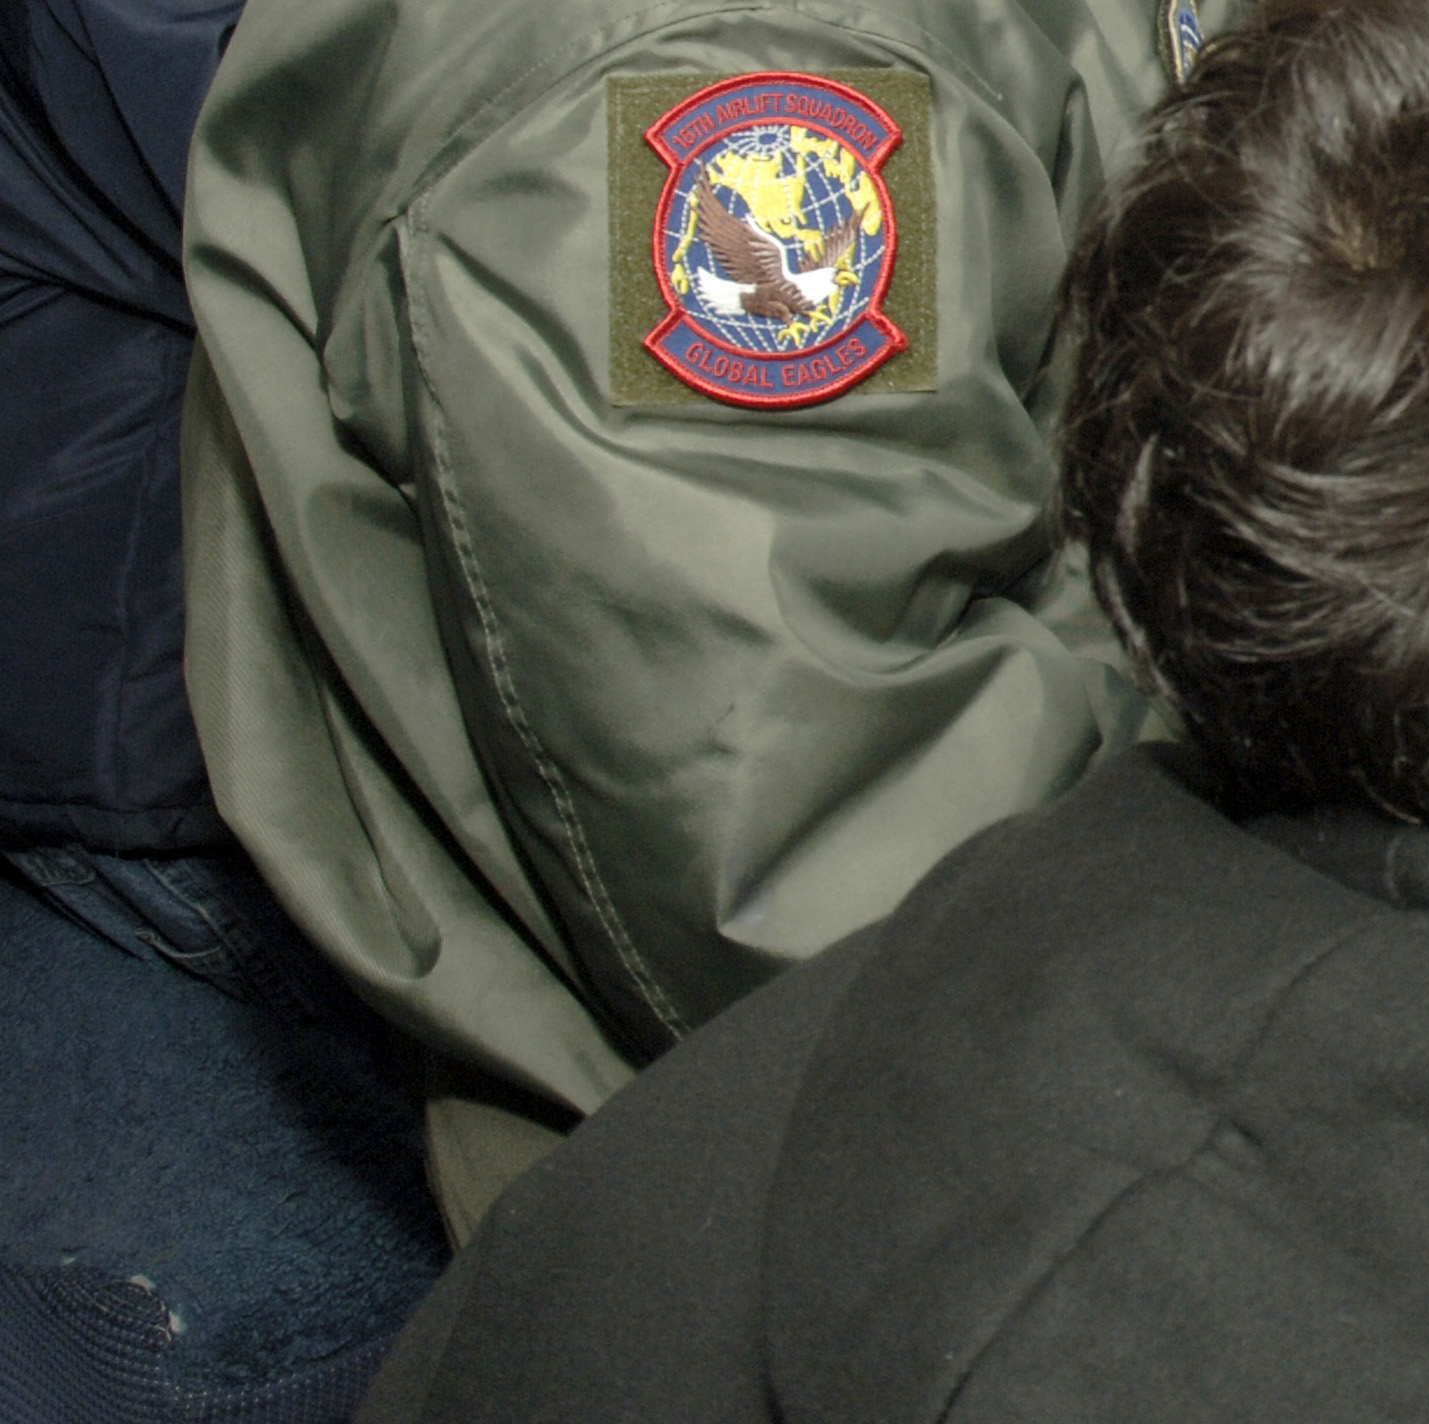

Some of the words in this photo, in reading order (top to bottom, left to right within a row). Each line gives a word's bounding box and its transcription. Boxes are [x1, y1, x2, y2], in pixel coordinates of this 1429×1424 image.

[672, 113, 716, 149] 15TH
[715, 93, 783, 124] AIRLIFT
[785, 94, 880, 150] SQUADRON
[686, 342, 774, 388] GLOBAL
[782, 337, 867, 387] EAGLES
